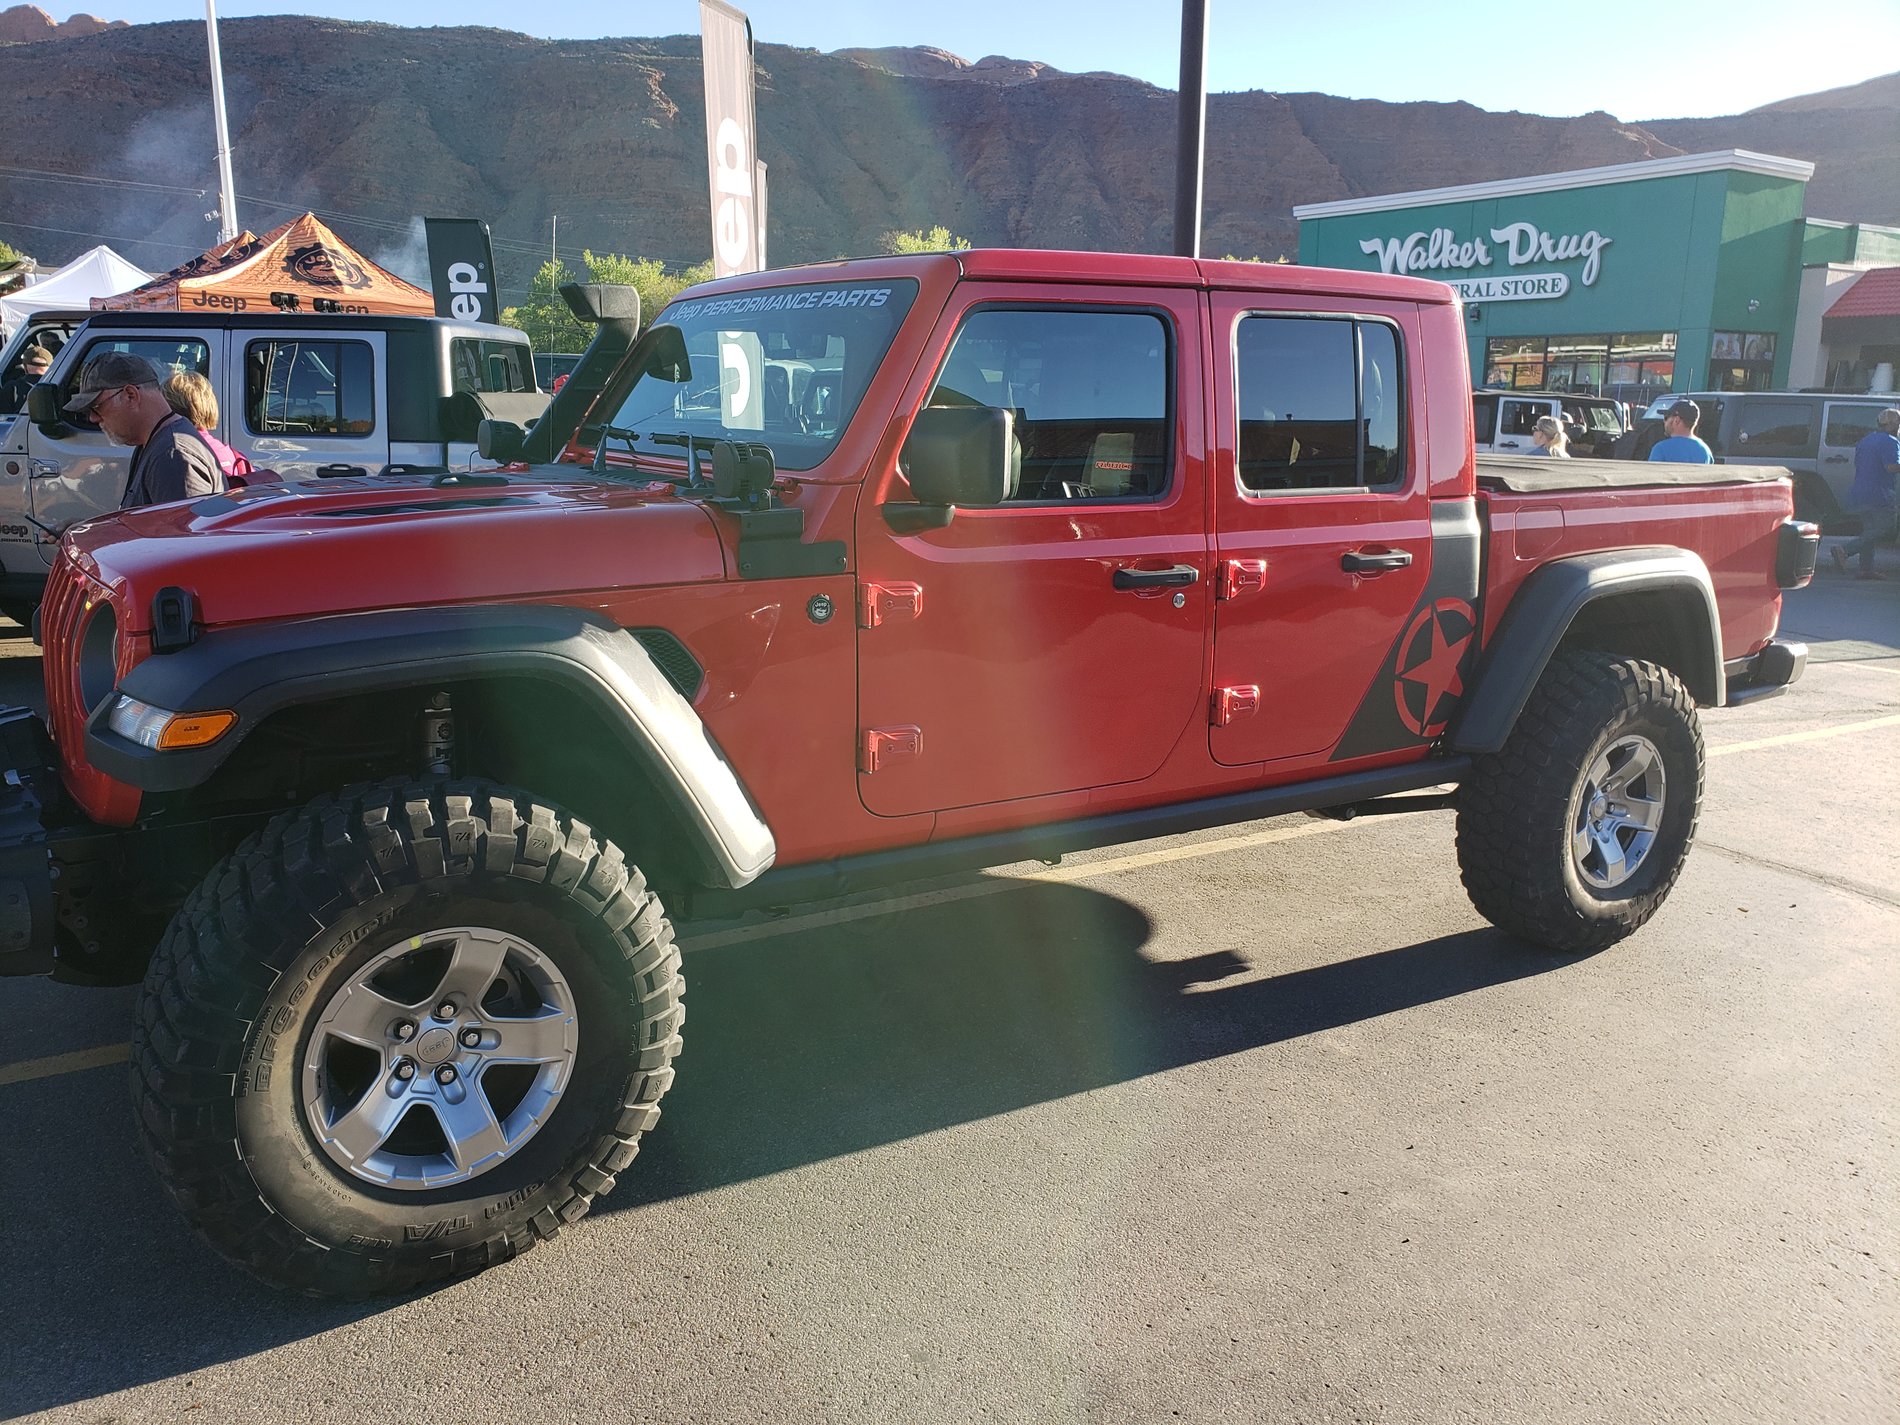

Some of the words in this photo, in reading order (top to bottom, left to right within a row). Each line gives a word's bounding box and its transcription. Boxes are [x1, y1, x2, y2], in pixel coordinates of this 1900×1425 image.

[1359, 227, 1493, 275] Walker
[1490, 222, 1613, 286] Drug
[192, 290, 247, 311] Jeep
[447, 262, 488, 322] ep
[1501, 277, 1562, 297] STORE
[670, 302, 702, 321] Jeep
[700, 291, 822, 317] PERFORMANCE
[819, 288, 892, 308] PARTS
[0, 524, 28, 537] eep
[255, 906, 396, 1093] BFGoodri
[422, 1036, 451, 1057] Jeep
[403, 1214, 475, 1242] T/A
